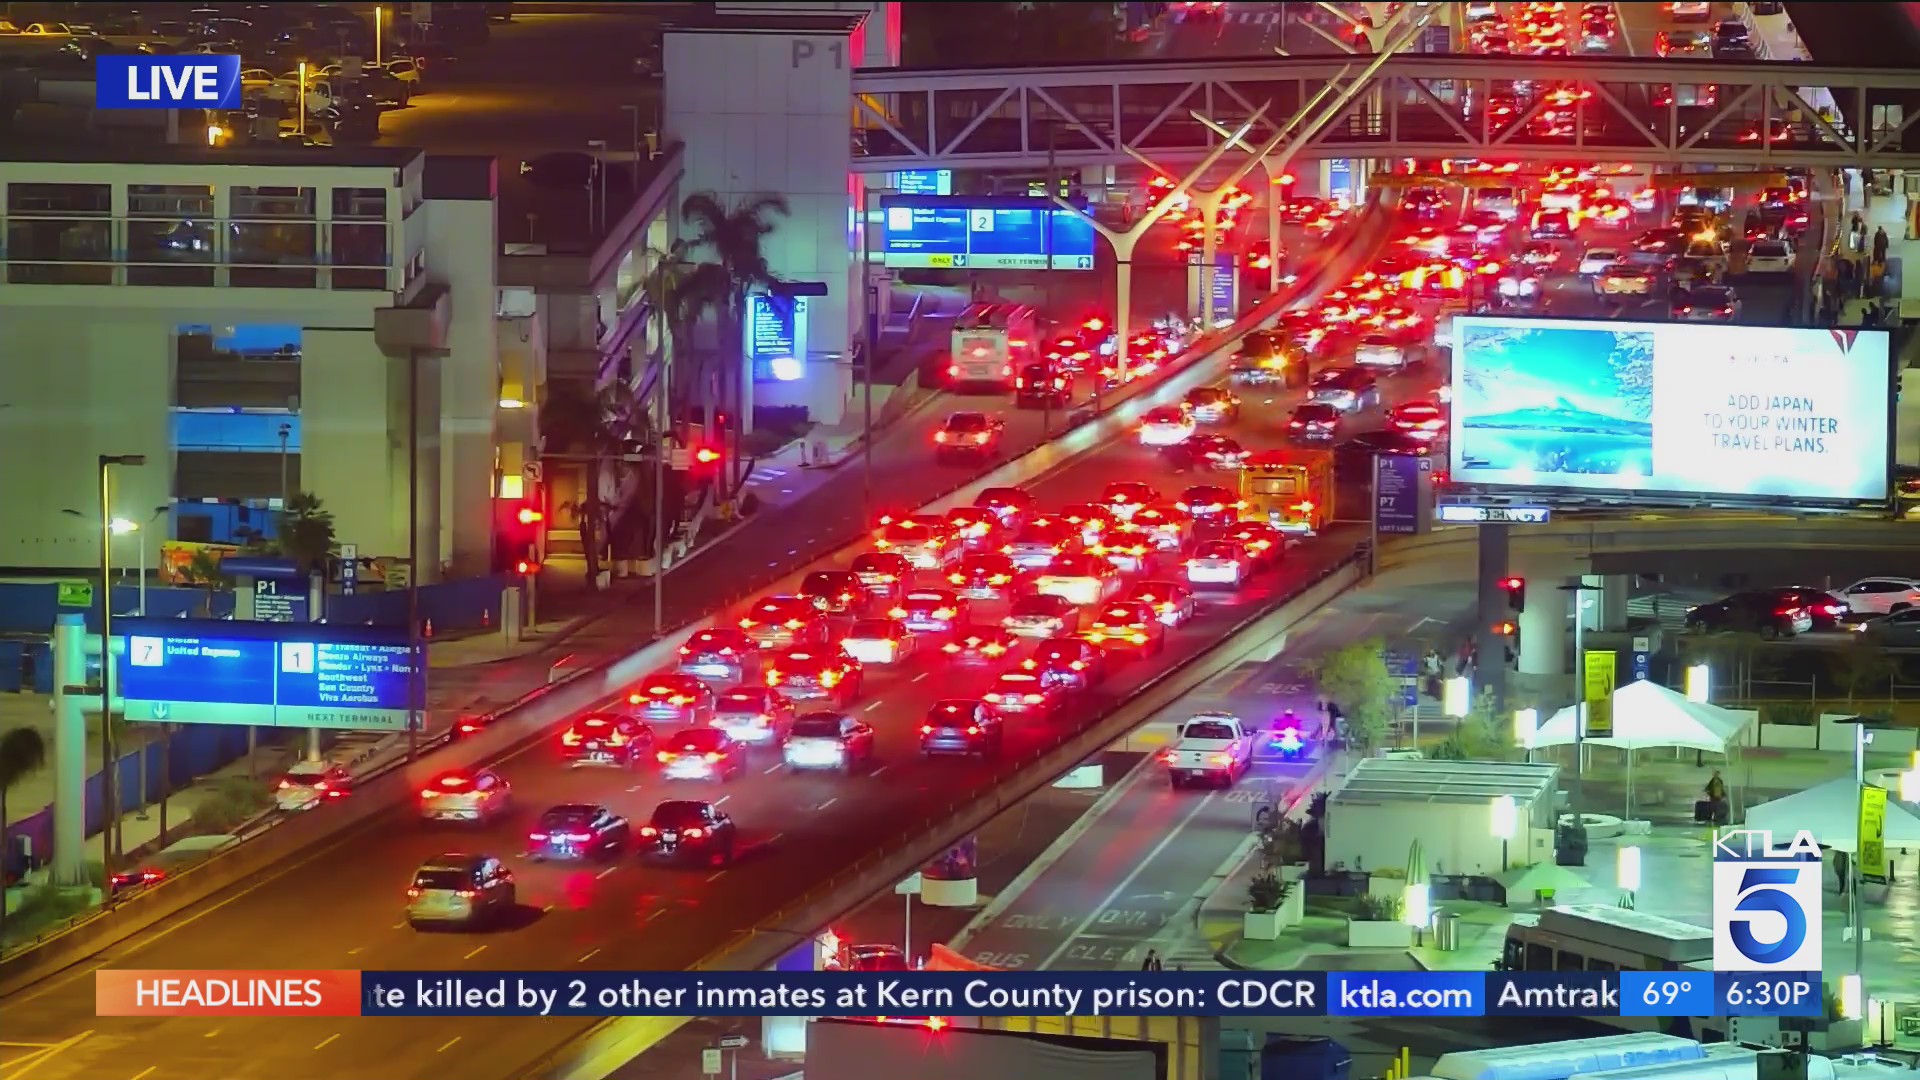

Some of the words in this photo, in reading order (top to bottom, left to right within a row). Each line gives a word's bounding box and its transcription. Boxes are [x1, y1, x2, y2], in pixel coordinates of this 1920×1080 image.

[978, 217, 988, 229] 2
[1728, 394, 1760, 411] ADD
[1765, 395, 1814, 412] JAPAN
[1704, 413, 1723, 429] TO
[1728, 414, 1770, 430] YOUR
[1776, 415, 1838, 434] WINTER
[1712, 433, 1769, 450] TRAVEL
[1775, 437, 1829, 453] PLANS.
[1379, 459, 1394, 469] P1
[1379, 497, 1395, 507] P7
[257, 580, 276, 595] P1
[143, 645, 153, 661] 7
[293, 651, 300, 668] 1
[307, 713, 335, 721] NEXT
[339, 714, 393, 724] TERMINAL
